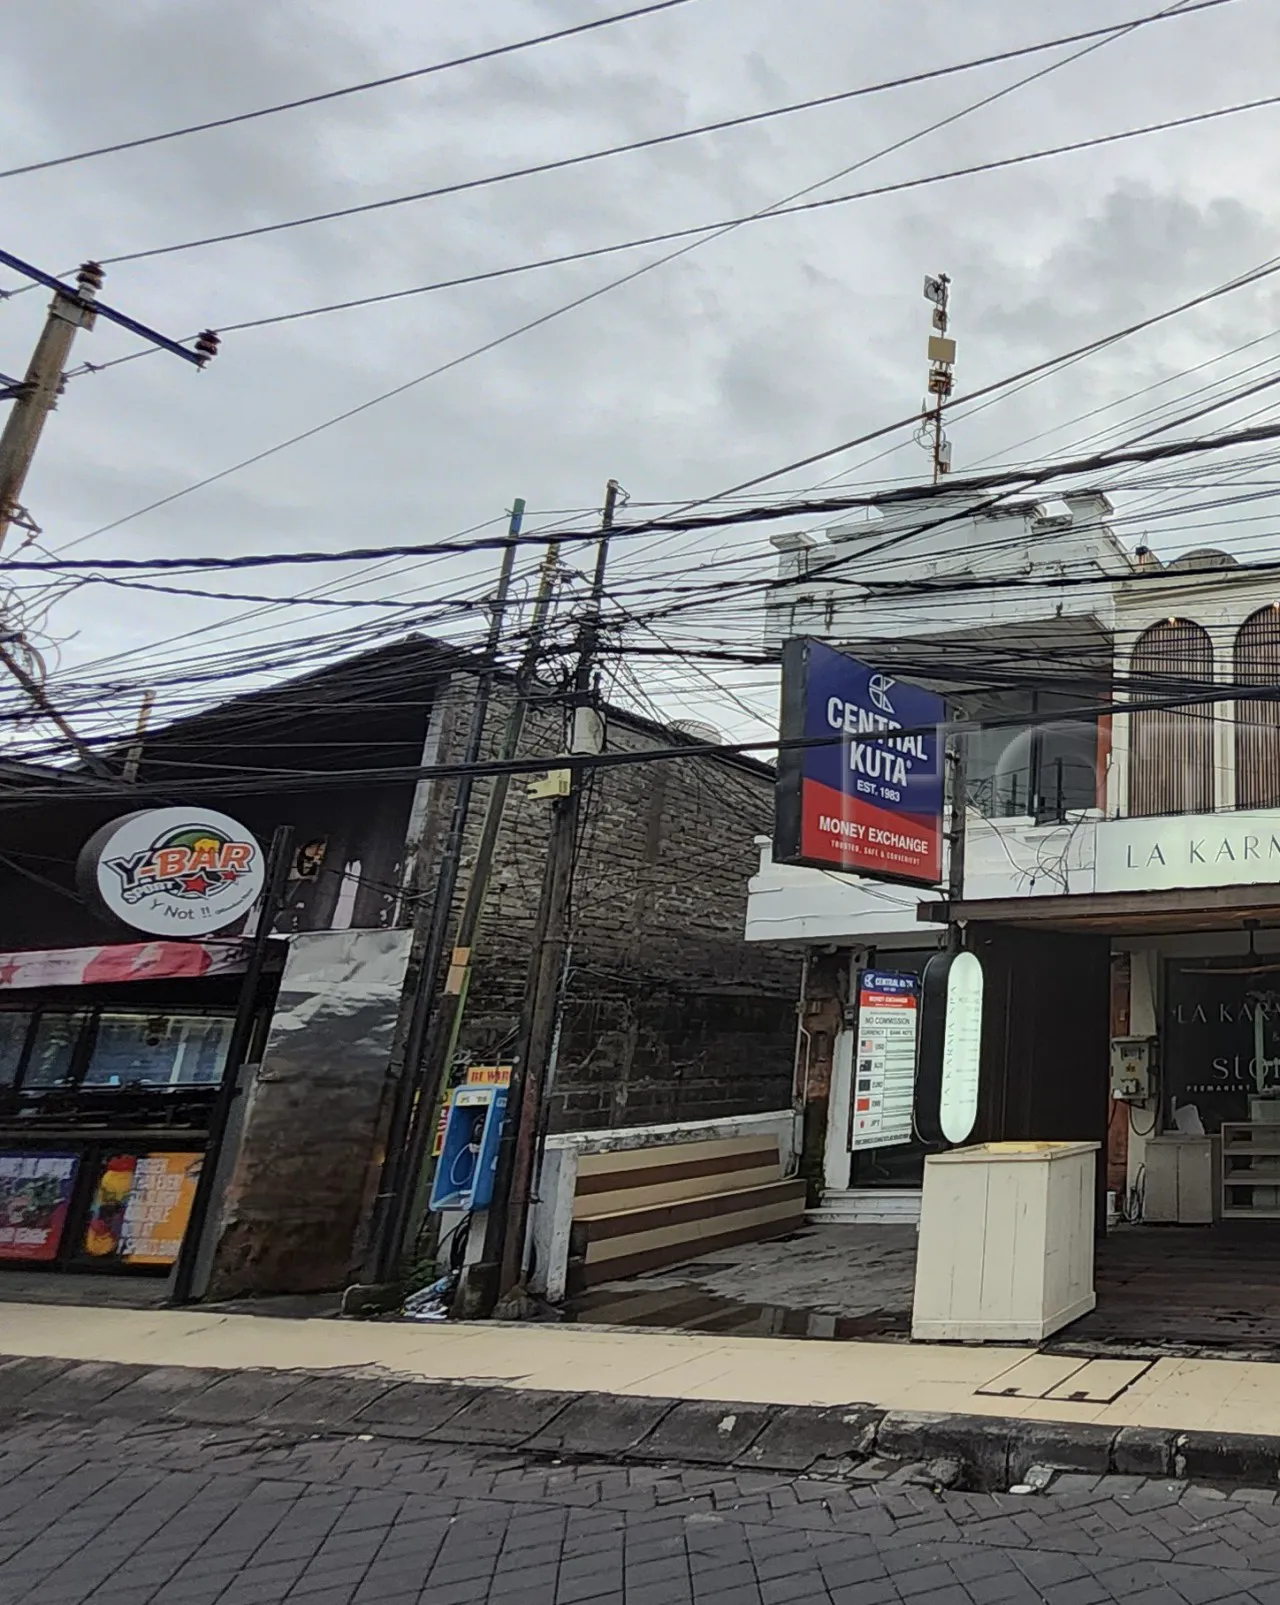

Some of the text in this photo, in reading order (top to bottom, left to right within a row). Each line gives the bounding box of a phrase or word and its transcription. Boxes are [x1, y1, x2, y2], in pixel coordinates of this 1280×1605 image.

[827, 696, 929, 761] CENTRAL
[849, 740, 908, 788] KUTA
[856, 779, 901, 803] EST. 1983
[819, 815, 929, 854] MONEY EXCHANGE
[106, 842, 252, 888] Y-BAR
[1127, 843, 1166, 869] LA
[164, 904, 196, 920] Not
[1177, 1003, 1208, 1024] LA
